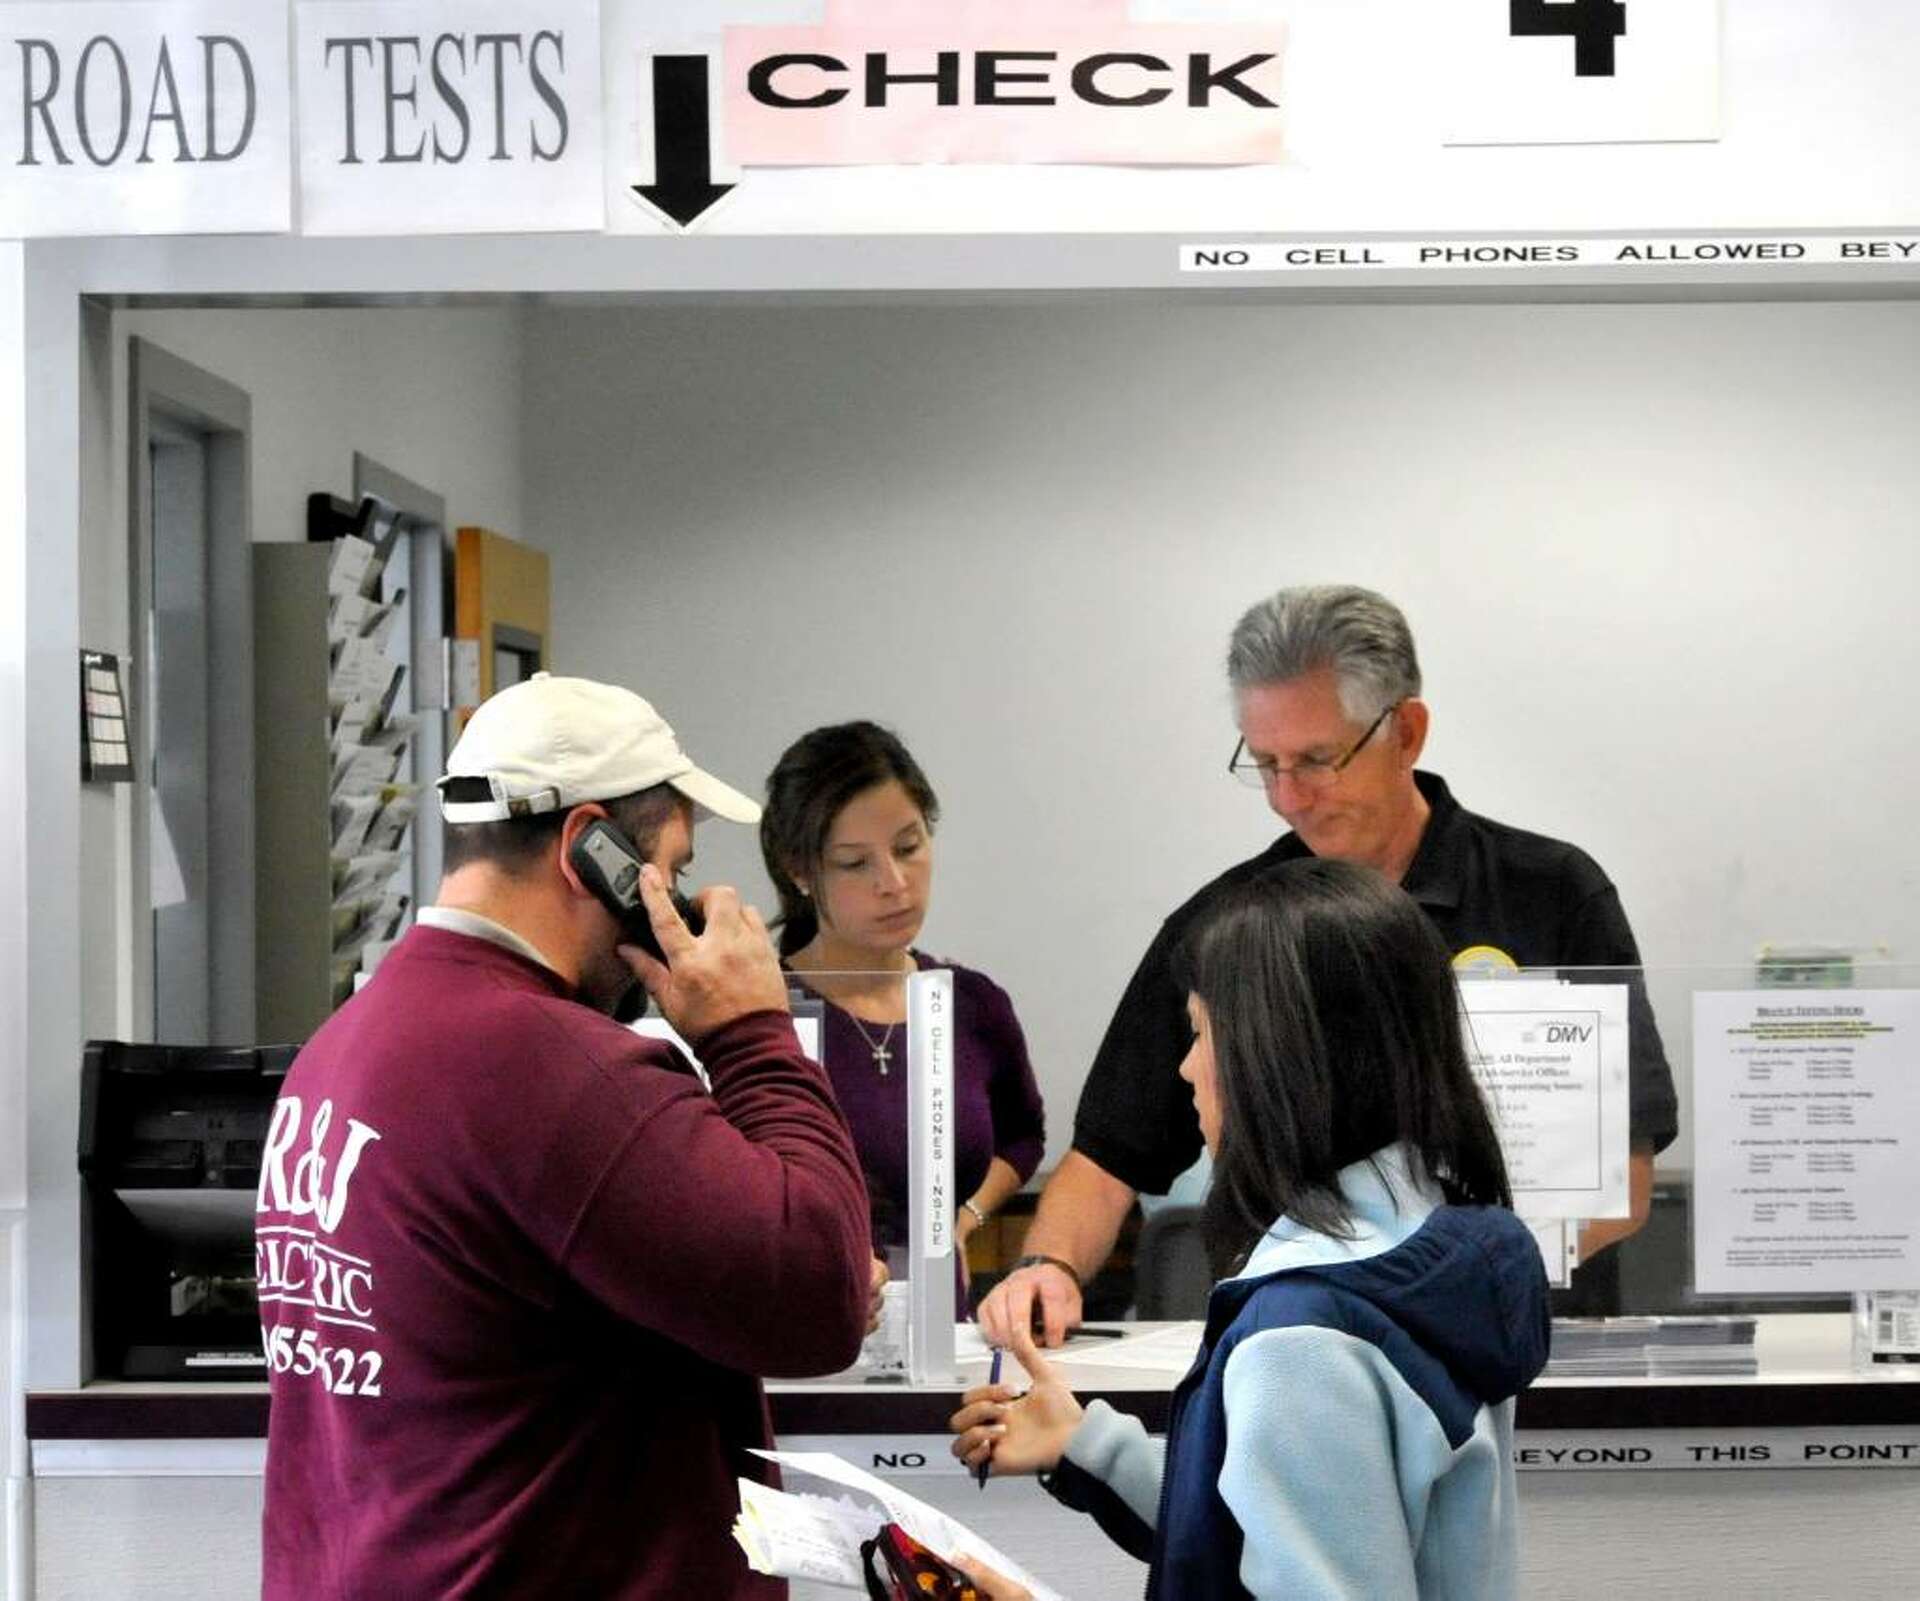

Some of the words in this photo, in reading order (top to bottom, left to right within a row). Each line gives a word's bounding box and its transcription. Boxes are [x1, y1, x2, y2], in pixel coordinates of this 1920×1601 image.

[14, 35, 256, 167] ROAD
[325, 30, 569, 164] TESTS
[747, 51, 1280, 109] CHECK
[1195, 250, 1249, 266] NO
[1285, 249, 1382, 265] CELL
[1420, 247, 1579, 263] PHONES
[1616, 243, 1806, 261] ALLOWED
[1840, 242, 1919, 258] BEY
[931, 990, 942, 1013] NO
[931, 1026, 943, 1076] CELL
[1546, 1026, 1592, 1043] DMV
[932, 1087, 944, 1161] PHONES
[932, 1173, 944, 1247] INSIDE
[873, 1453, 926, 1468] NO
[1513, 1447, 1652, 1465] EYOND
[1685, 1444, 1772, 1462] THIS
[1803, 1444, 1920, 1462] POINT
